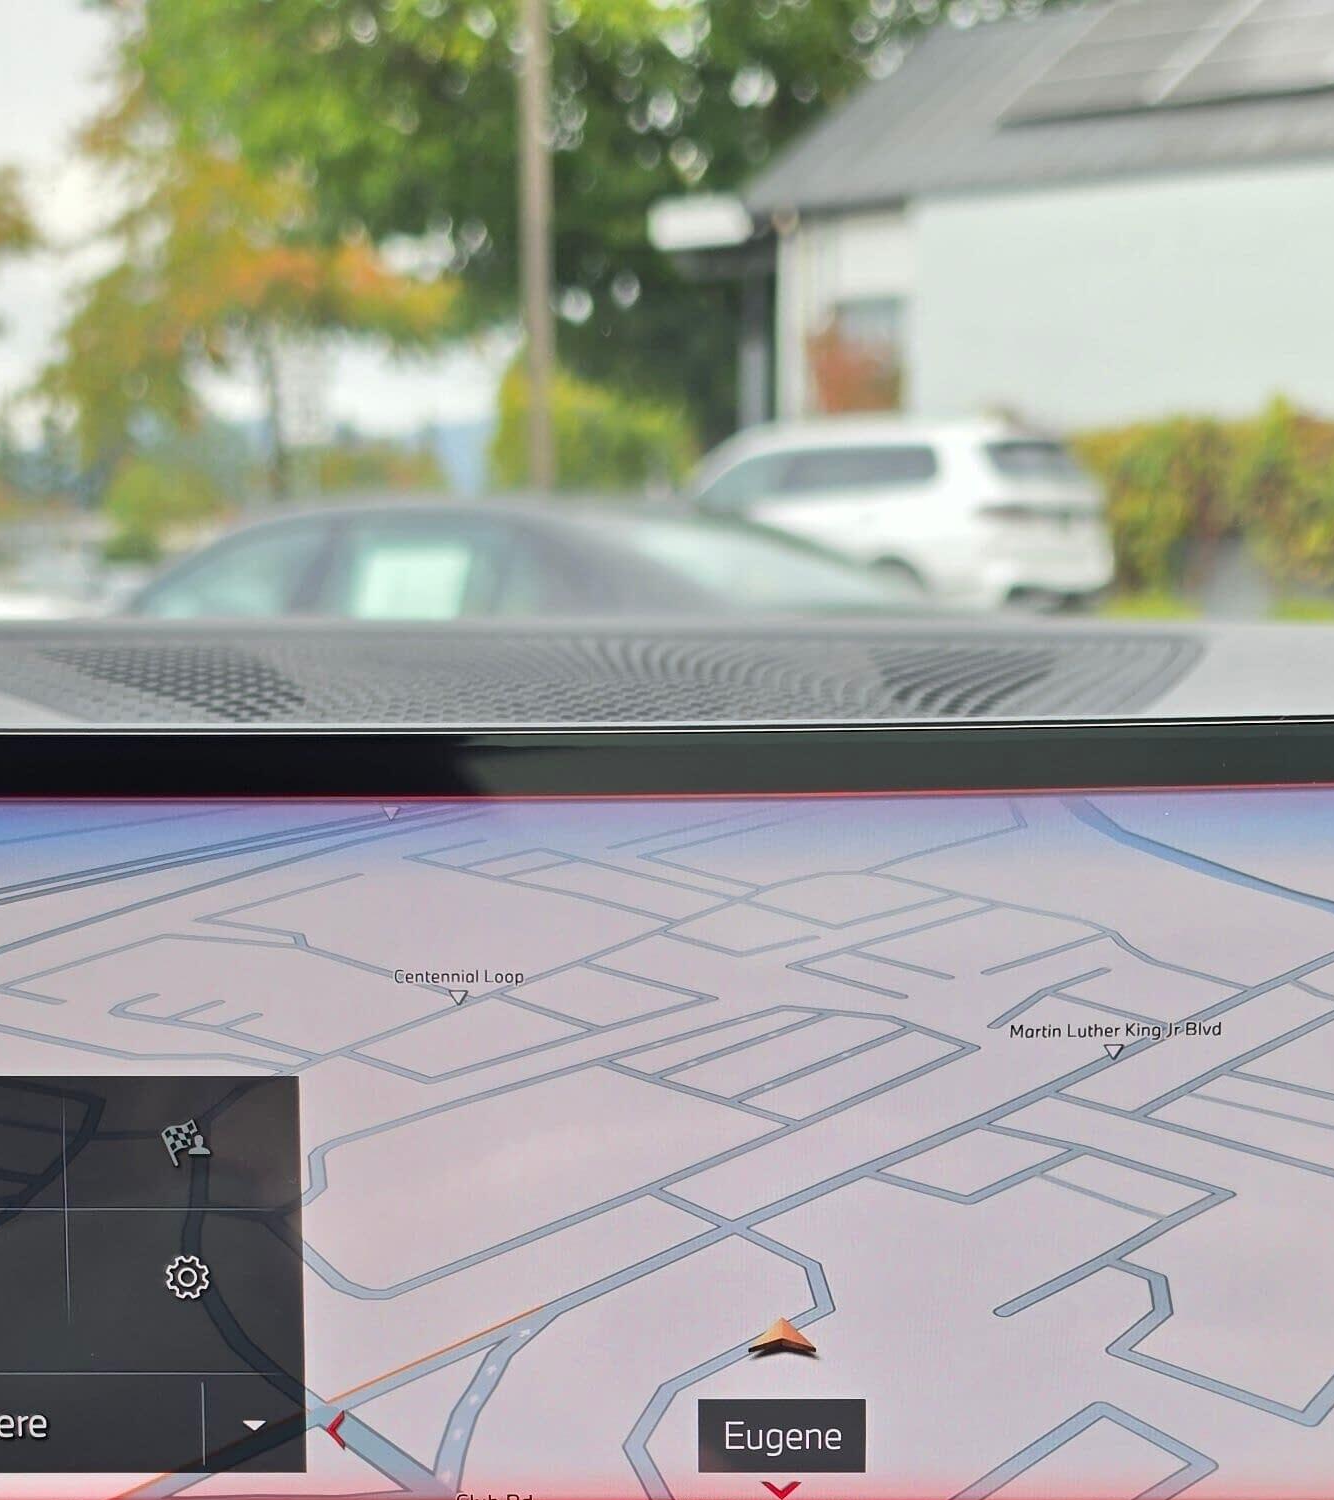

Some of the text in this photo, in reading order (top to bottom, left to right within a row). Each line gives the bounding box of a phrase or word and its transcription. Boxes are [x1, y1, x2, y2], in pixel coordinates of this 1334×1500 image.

[394, 968, 525, 988] Centennial Loop
[1009, 1021, 1222, 1041] Martin Luther King Jr Blvd
[724, 1421, 843, 1456] Eugene
